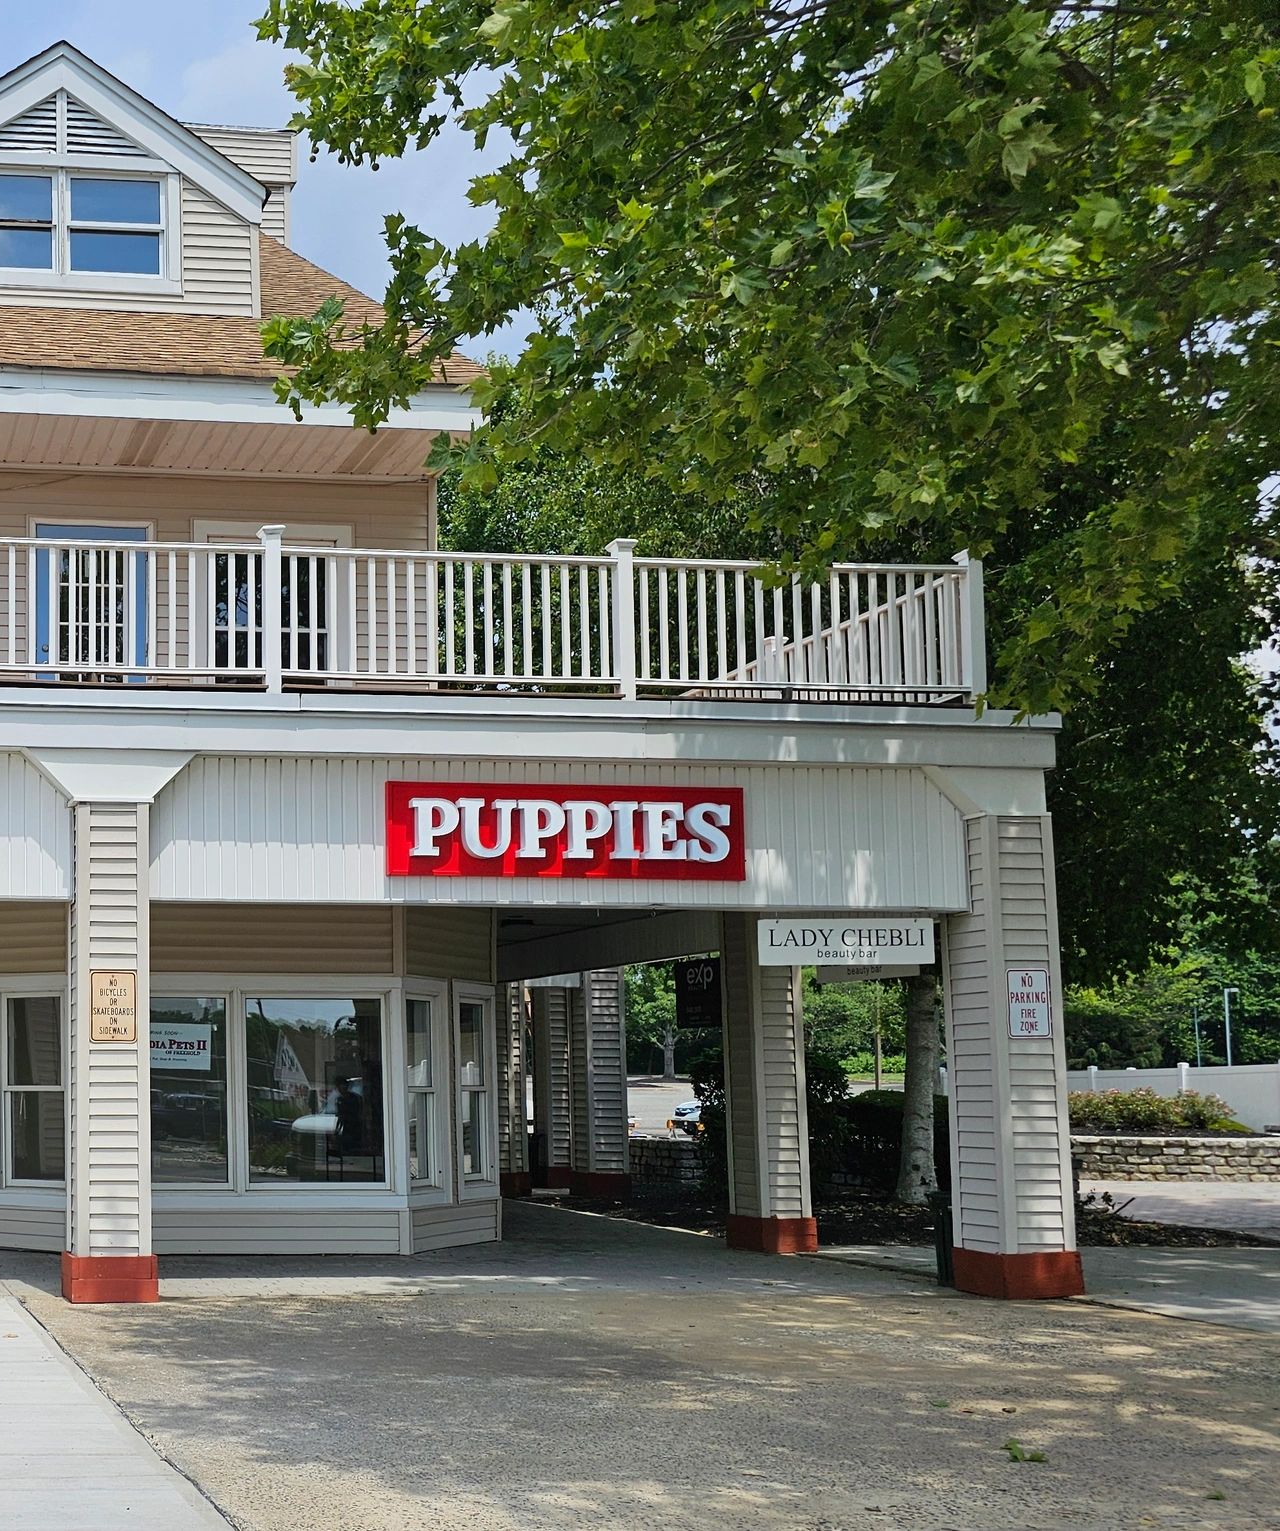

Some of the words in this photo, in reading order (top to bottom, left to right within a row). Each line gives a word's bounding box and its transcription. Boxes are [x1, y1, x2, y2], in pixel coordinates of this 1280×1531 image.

[409, 797, 731, 863] PUPPIES
[768, 928, 835, 947] LADY
[841, 928, 927, 947] CHEBLI
[817, 949, 856, 960] beauty
[858, 948, 878, 958] bar
[109, 979, 118, 987] NO
[1021, 975, 1033, 987] NO
[99, 988, 127, 997] BICYCLES
[1010, 991, 1046, 1004] PARKING
[109, 998, 118, 1006] OR
[93, 1007, 134, 1016] SKATEBOARDS
[1021, 1008, 1037, 1018] FIRE
[109, 1017, 118, 1025] ON
[1020, 1021, 1039, 1031] ZONE
[99, 1026, 128, 1035] SIDEWALK
[167, 1039, 195, 1050] PETS
[196, 1039, 208, 1050] II
